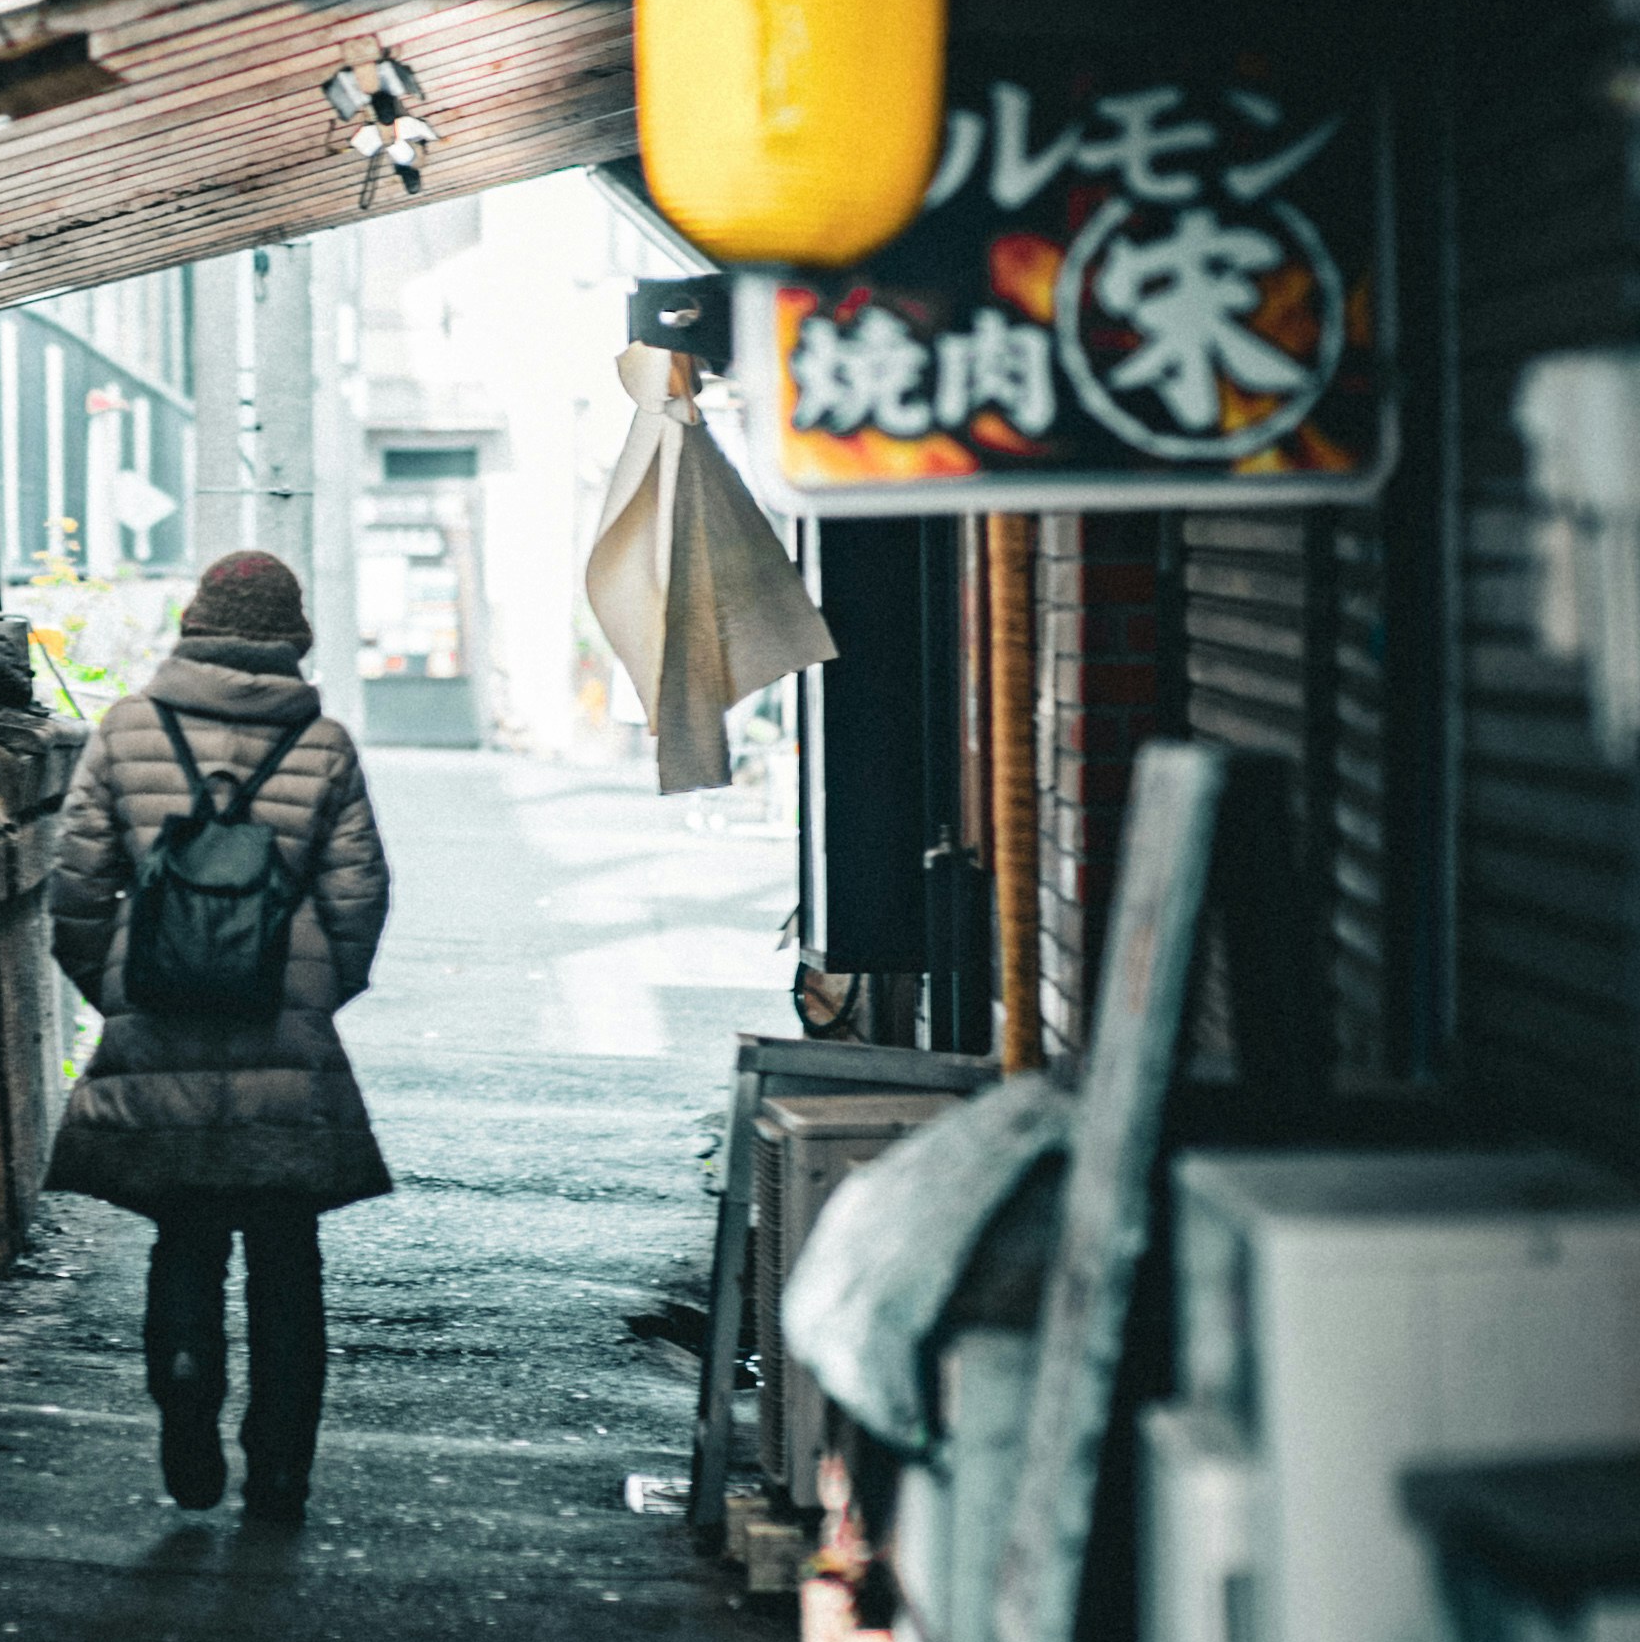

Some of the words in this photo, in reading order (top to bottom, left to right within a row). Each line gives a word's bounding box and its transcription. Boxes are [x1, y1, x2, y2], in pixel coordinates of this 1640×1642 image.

[924, 80, 1346, 210] ルモン
[790, 306, 1057, 437] 焼肉
